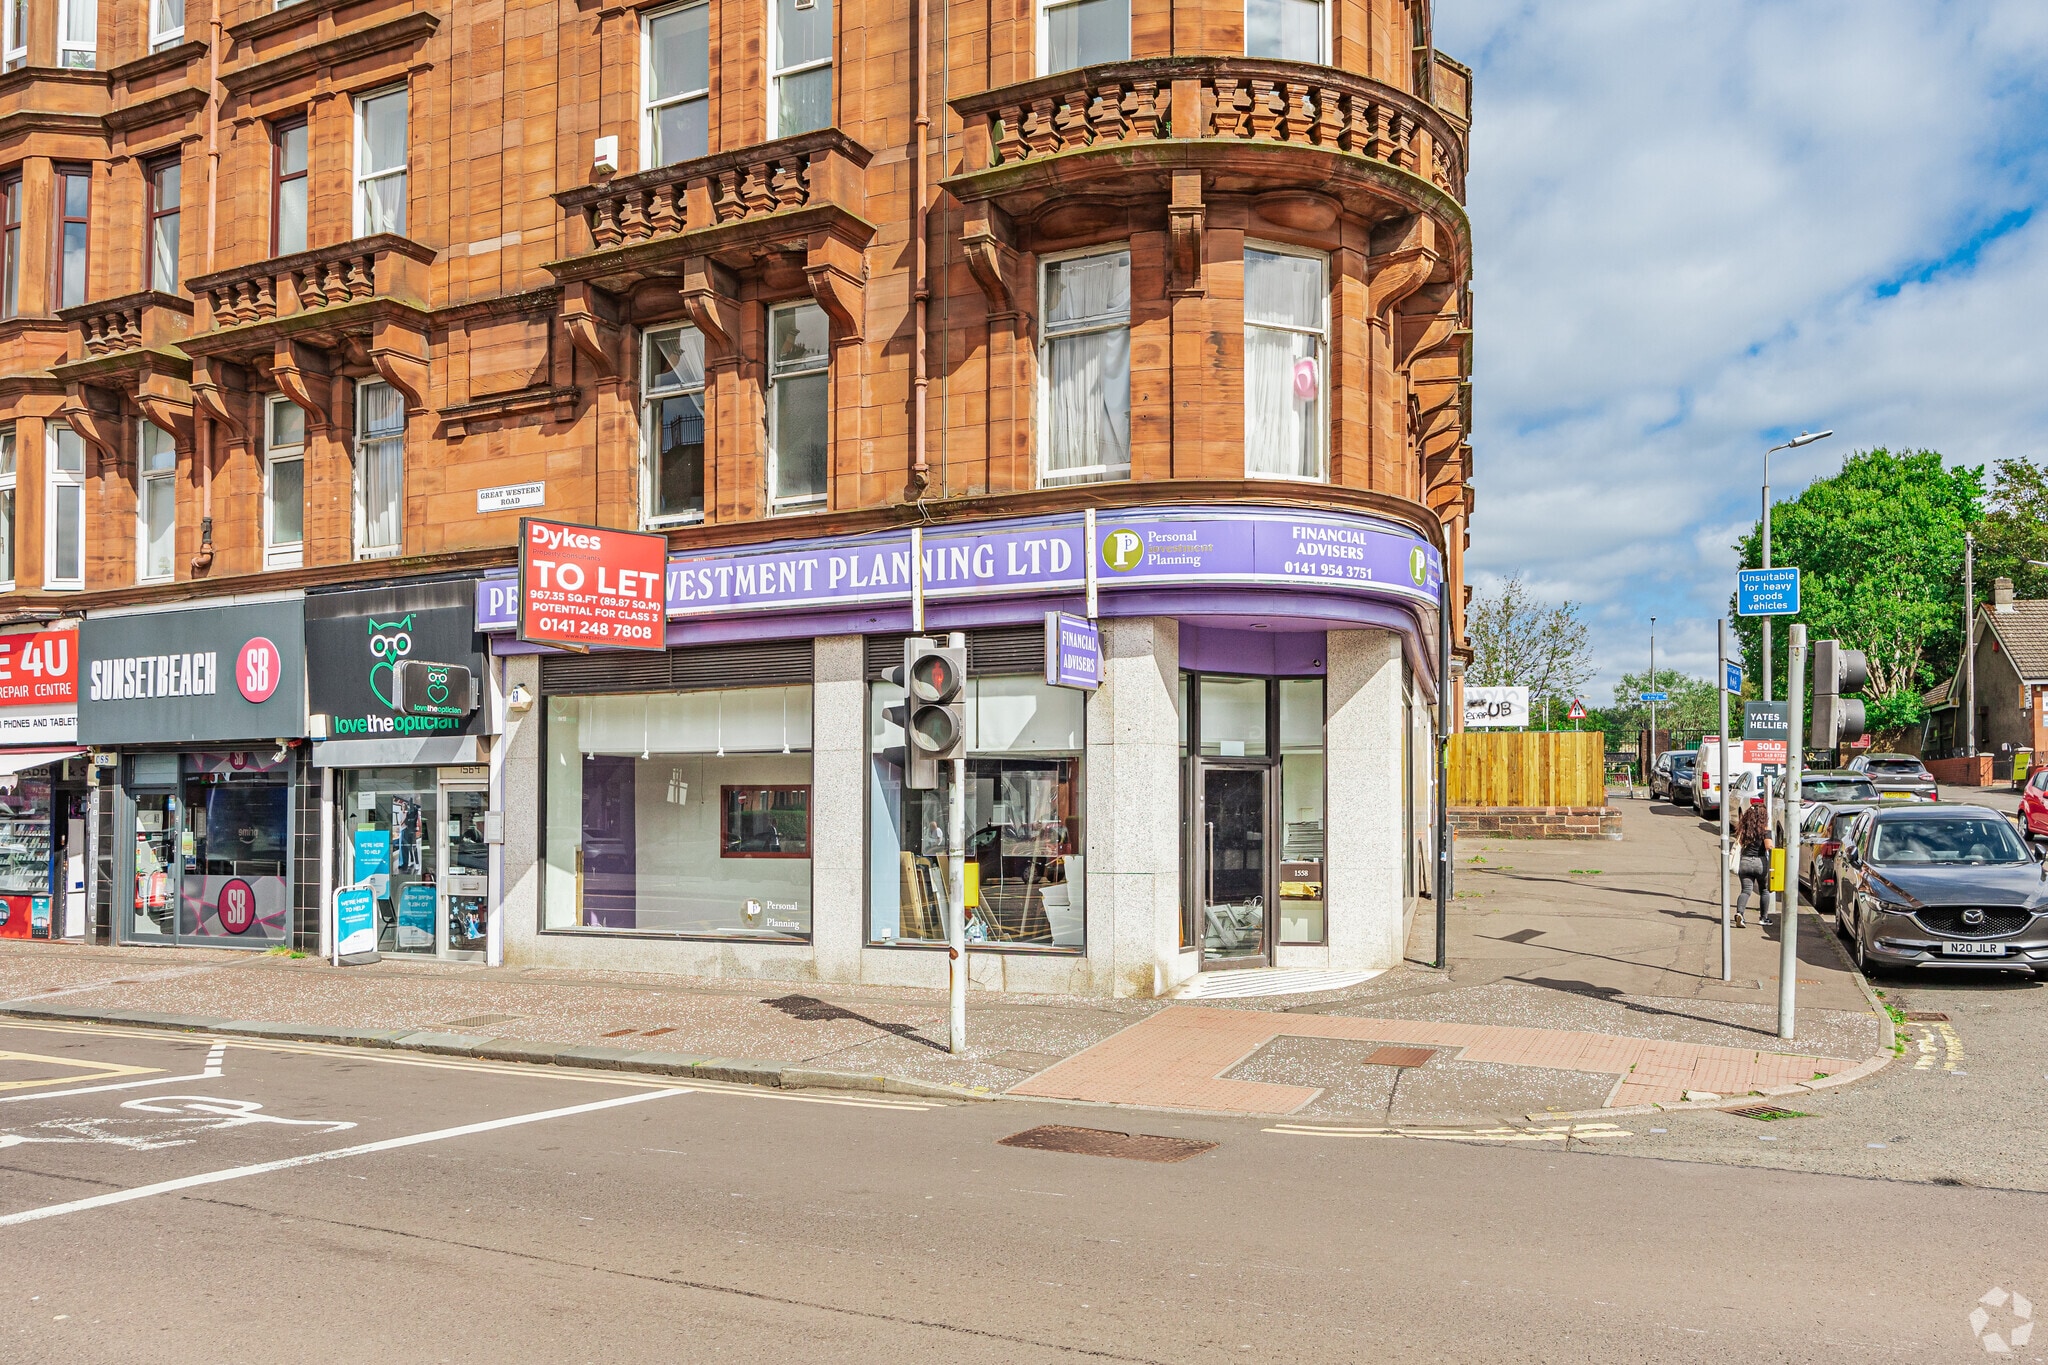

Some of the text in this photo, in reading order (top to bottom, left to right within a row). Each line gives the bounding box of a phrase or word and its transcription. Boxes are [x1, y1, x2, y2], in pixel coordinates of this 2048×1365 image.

[480, 486, 541, 499] GREAT WESTERN
[532, 524, 601, 550] Dykes
[1148, 530, 1197, 543] Personal
[1292, 526, 1367, 545] FINANCIAL
[533, 549, 601, 562] Property Consultants
[1148, 553, 1201, 567] Planning
[1296, 542, 1364, 560] ADVISERS
[828, 543, 995, 589] PLANNING
[1007, 538, 1072, 576] LTD
[1284, 561, 1372, 580] 0141 954 3751
[533, 560, 660, 599] TO LET
[1741, 572, 1795, 582] Unsuitable
[1744, 583, 1791, 591] for heavy
[530, 589, 661, 612] 967.35 SQ.FT (89.87 SQ.M)
[1748, 602, 1788, 610] vehicles
[1753, 592, 1783, 602] goods
[532, 602, 658, 622] POTENTIAL FOR CLASS 3
[540, 617, 652, 639] 0141 248 7808
[1062, 630, 1096, 652] FINANCIAL
[20, 639, 68, 677] 4U
[1063, 653, 1095, 673] ADVISERS
[90, 652, 217, 701] SUNSETBEACH
[246, 648, 269, 692] SB
[34, 682, 72, 696] CENTRE
[3, 719, 30, 728] PHONES
[33, 718, 47, 727] AND
[227, 889, 246, 924] SB
[767, 900, 798, 910] Personal
[767, 917, 800, 930] Planning
[1951, 943, 1997, 952] N20 JLR
